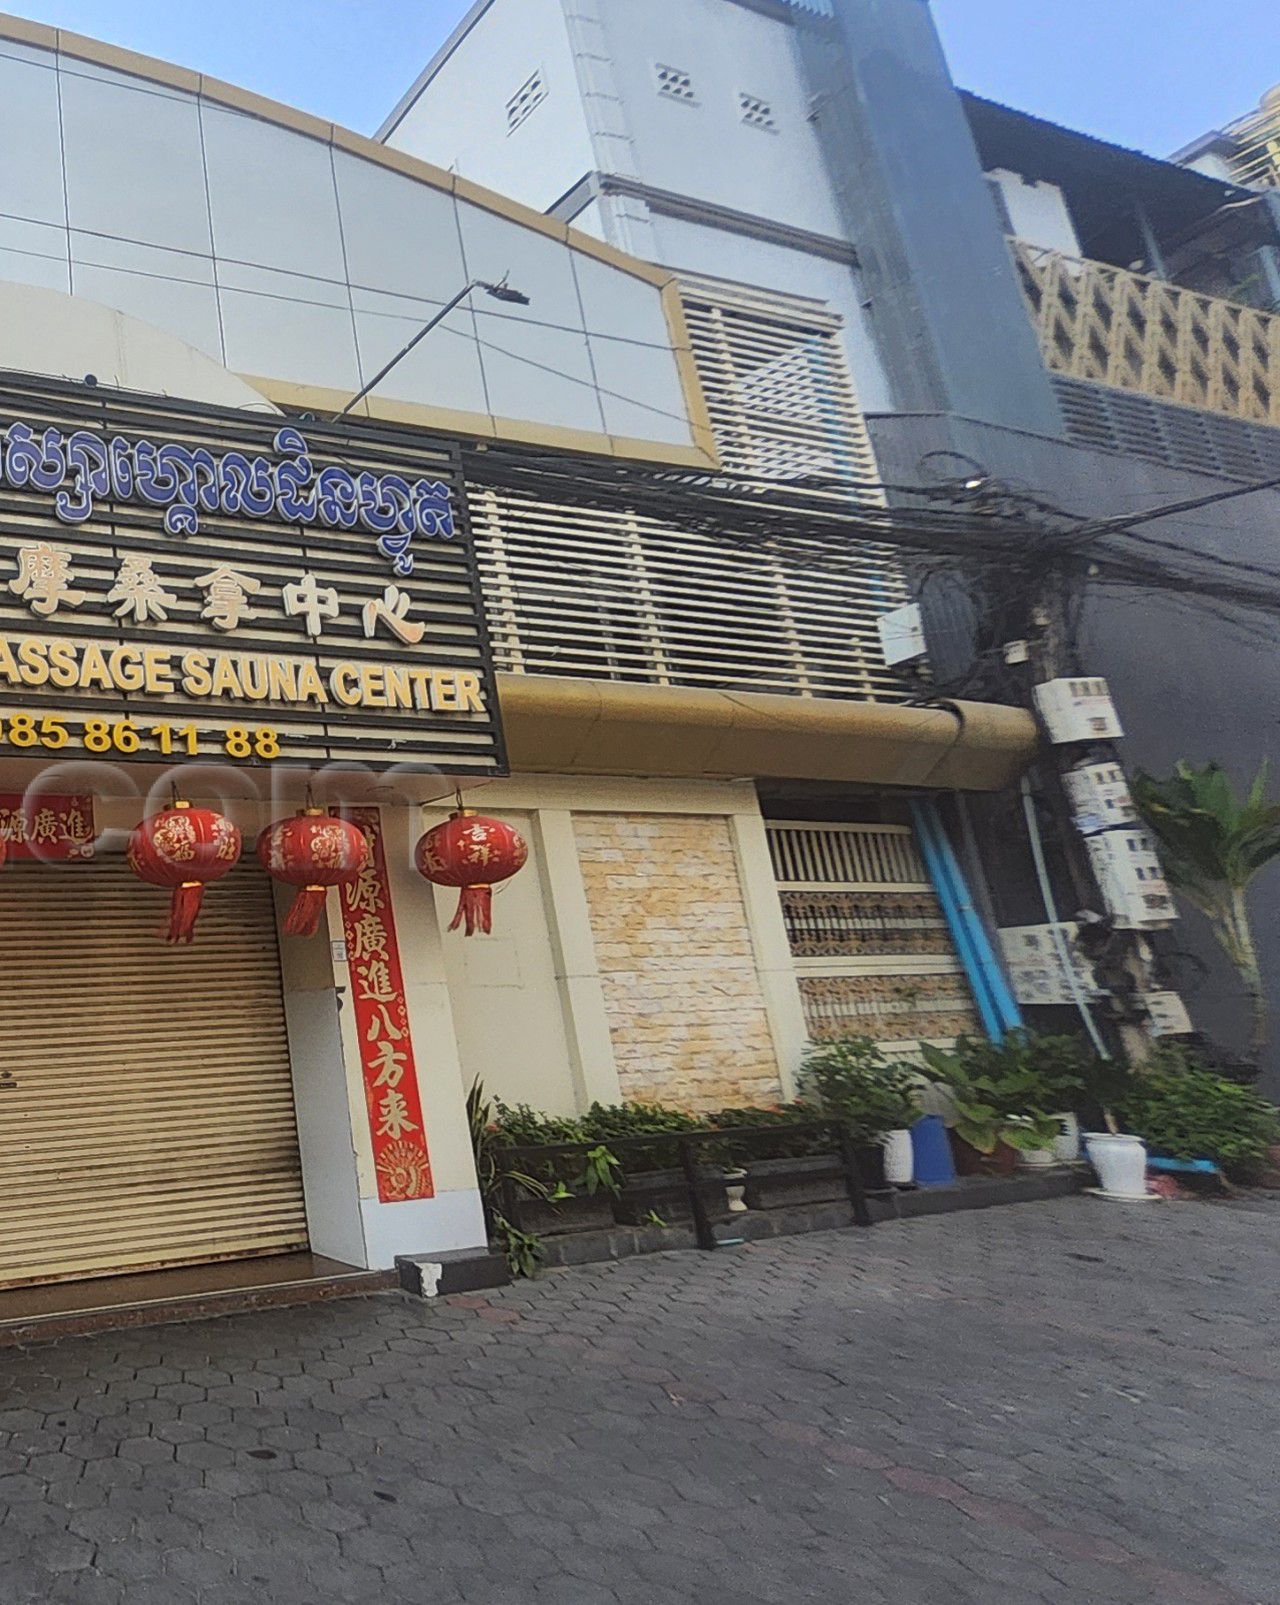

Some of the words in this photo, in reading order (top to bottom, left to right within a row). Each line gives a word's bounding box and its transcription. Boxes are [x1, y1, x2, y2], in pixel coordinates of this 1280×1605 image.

[181, 652, 330, 706] SAUNA
[330, 664, 488, 713] CENTER
[83, 721, 141, 755] 86
[151, 722, 201, 757] 11
[225, 727, 281, 759] 88
[461, 823, 496, 867] 吉祥
